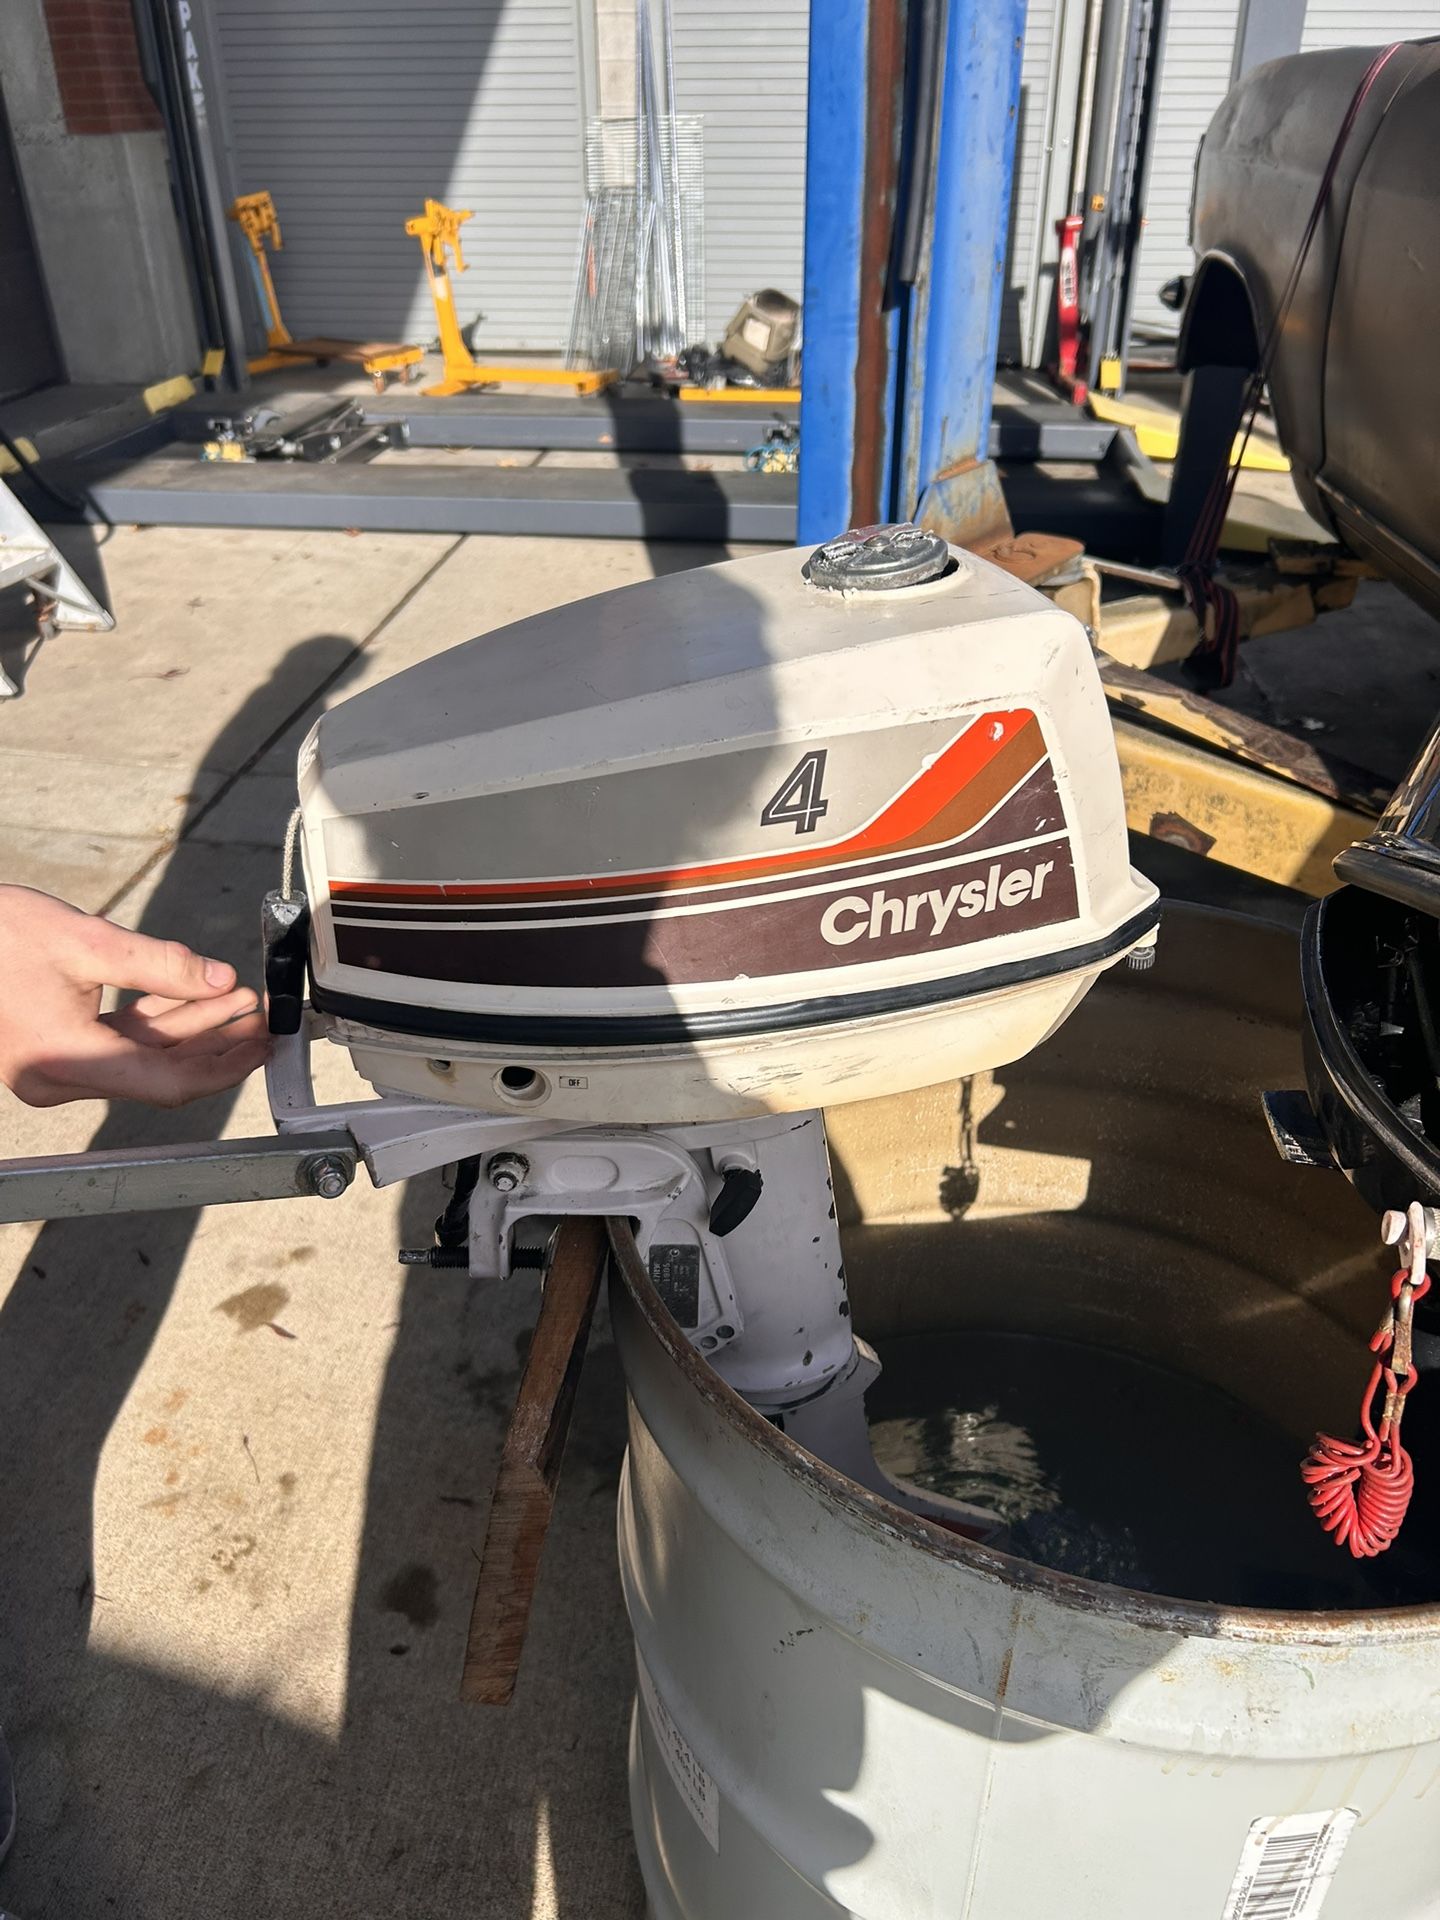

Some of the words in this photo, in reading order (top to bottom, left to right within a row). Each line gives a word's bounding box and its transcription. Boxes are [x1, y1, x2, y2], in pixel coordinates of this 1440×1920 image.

[761, 749, 828, 834] 4
[819, 860, 1054, 945] Chrysler
[568, 1078, 580, 1087] OFF
